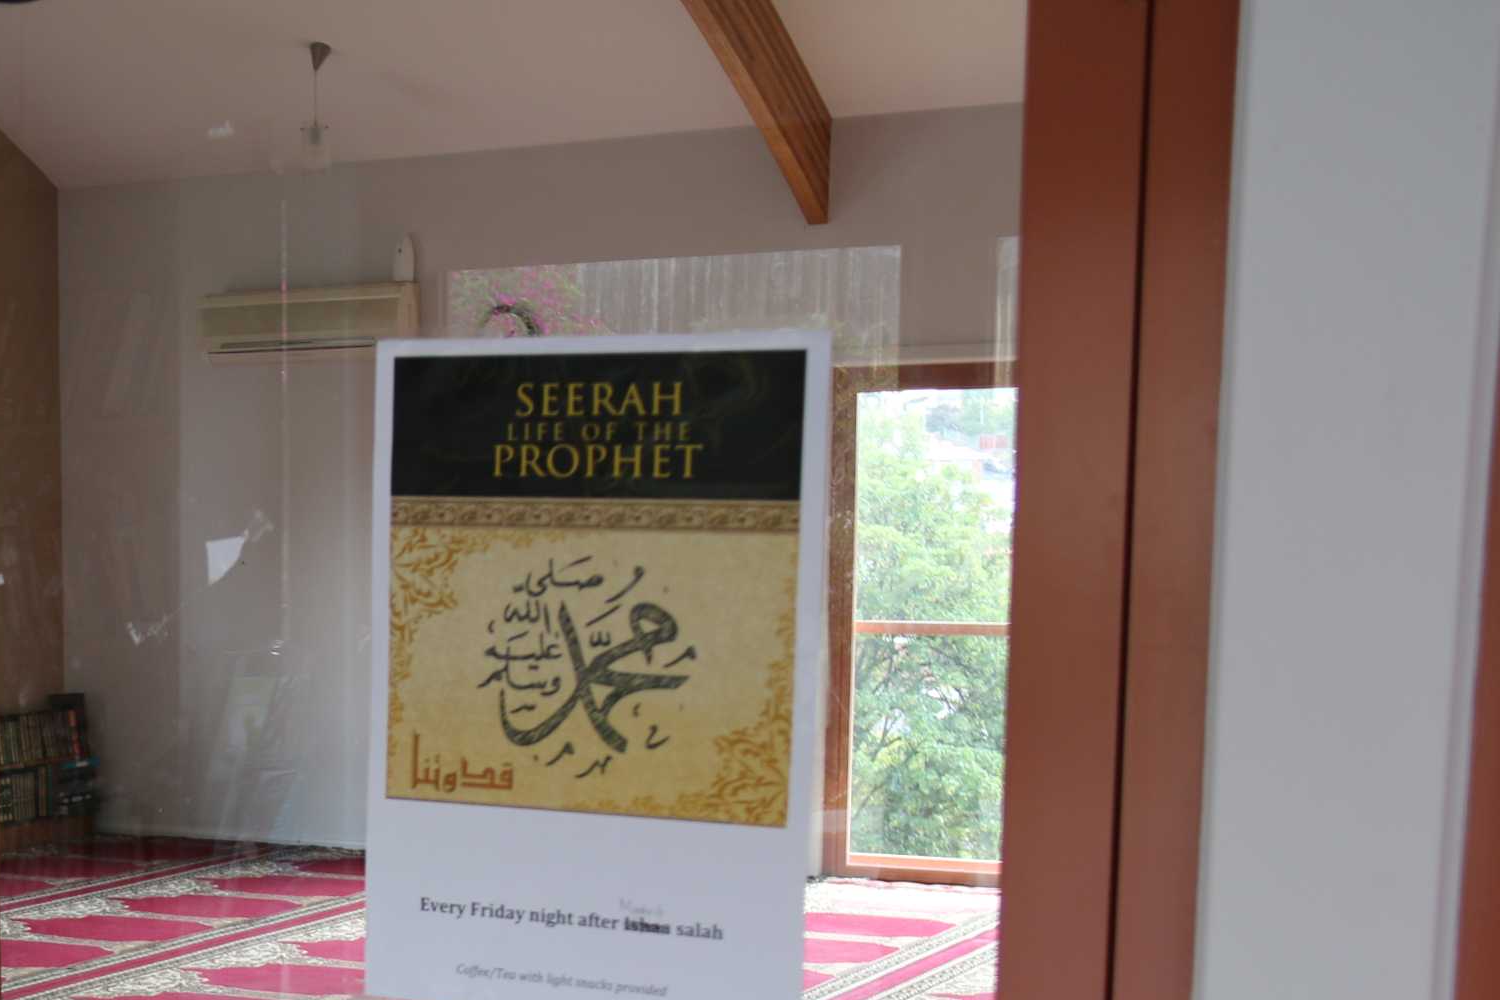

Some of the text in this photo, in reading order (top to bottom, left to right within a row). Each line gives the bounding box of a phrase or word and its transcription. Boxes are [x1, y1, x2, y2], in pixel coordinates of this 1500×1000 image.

[515, 381, 683, 417] SEERAH
[508, 421, 691, 441] LIFE OF THE
[493, 443, 704, 479] PROPHET
[420, 896, 465, 919] Every
[471, 901, 525, 924] Friday
[529, 906, 573, 928] night
[577, 911, 620, 930] after
[676, 921, 724, 941] salah
[455, 962, 669, 997] Coffee/Tea with light snacks provided
